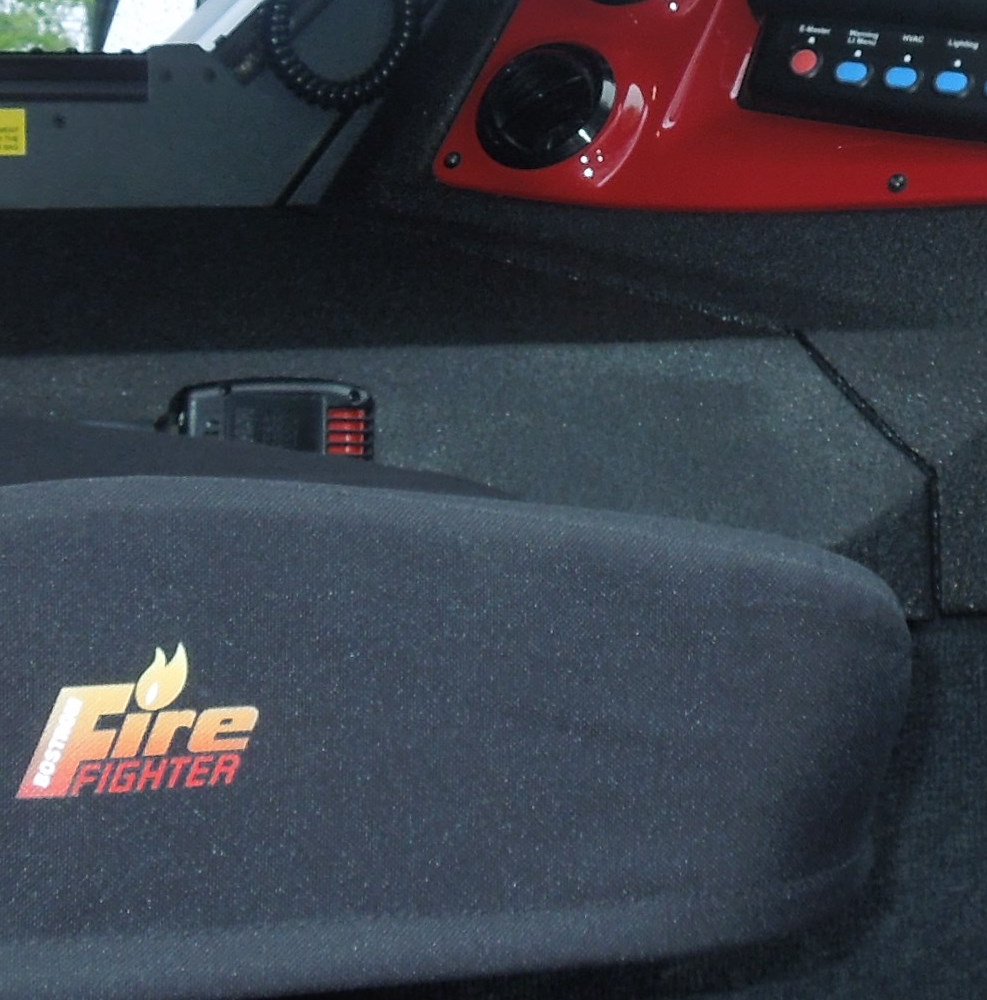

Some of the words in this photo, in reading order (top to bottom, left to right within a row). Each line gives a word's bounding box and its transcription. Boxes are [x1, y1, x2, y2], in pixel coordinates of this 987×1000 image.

[902, 33, 925, 43] HVAC
[947, 39, 980, 51] Lighting
[16, 641, 259, 799] Fire
[71, 754, 241, 797] FIGHTER
